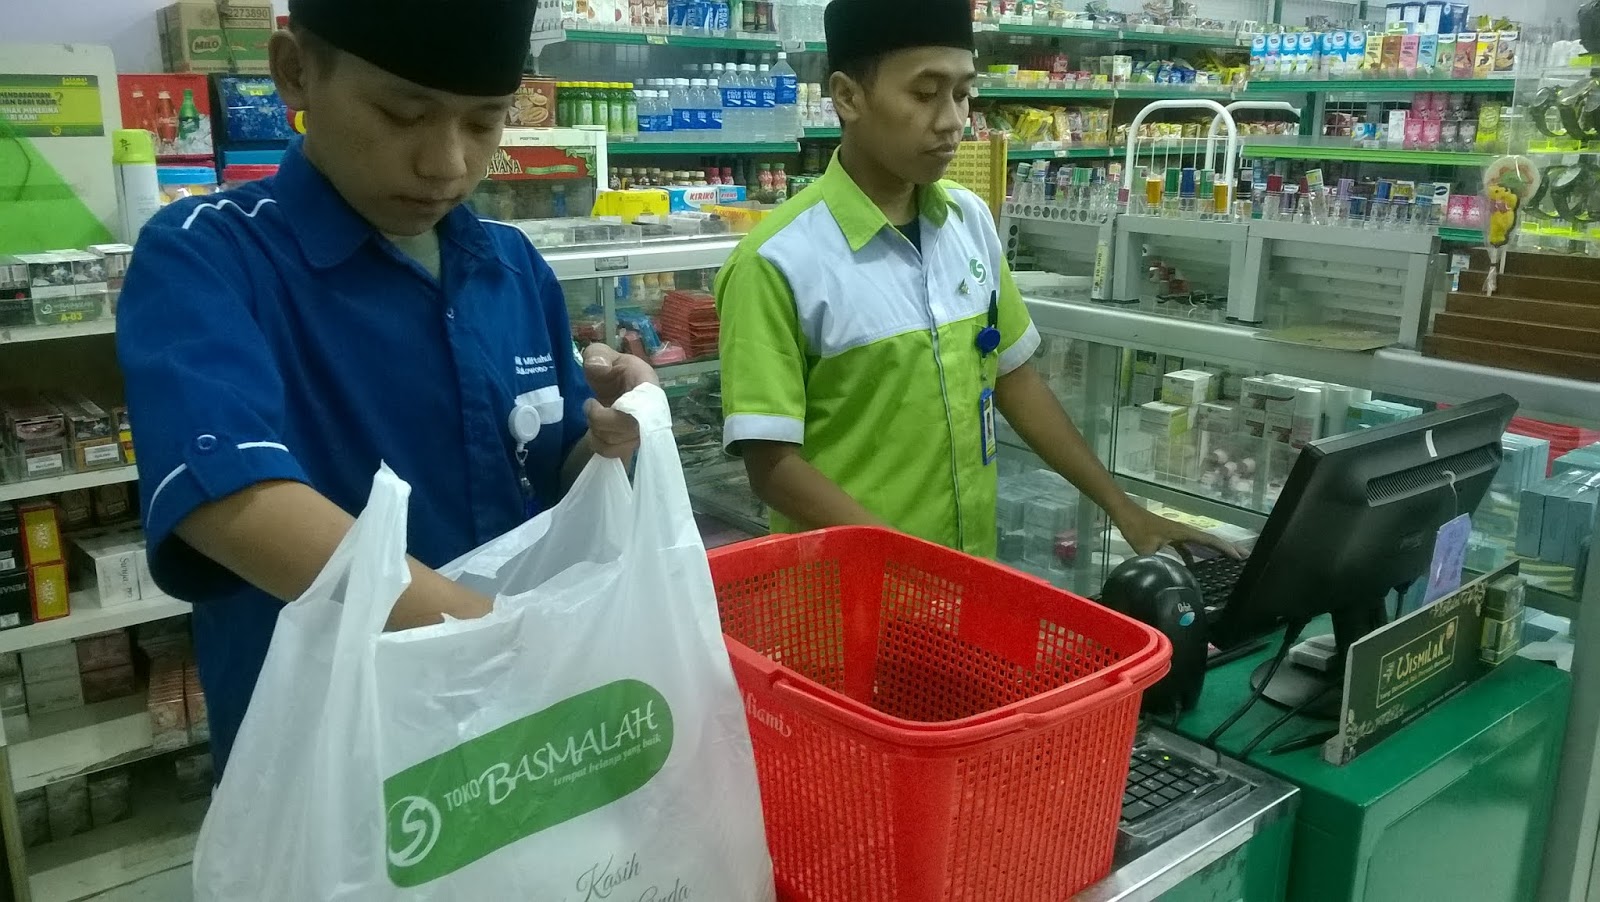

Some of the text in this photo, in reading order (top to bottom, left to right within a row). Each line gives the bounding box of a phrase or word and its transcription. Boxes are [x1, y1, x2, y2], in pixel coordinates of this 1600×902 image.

[195, 41, 219, 50] MILO
[689, 191, 715, 201] KIRIKO
[443, 699, 659, 812] TOKO BASMALAH
[554, 732, 662, 787] tempat belanja yang baik
[576, 852, 640, 902] Kasih
